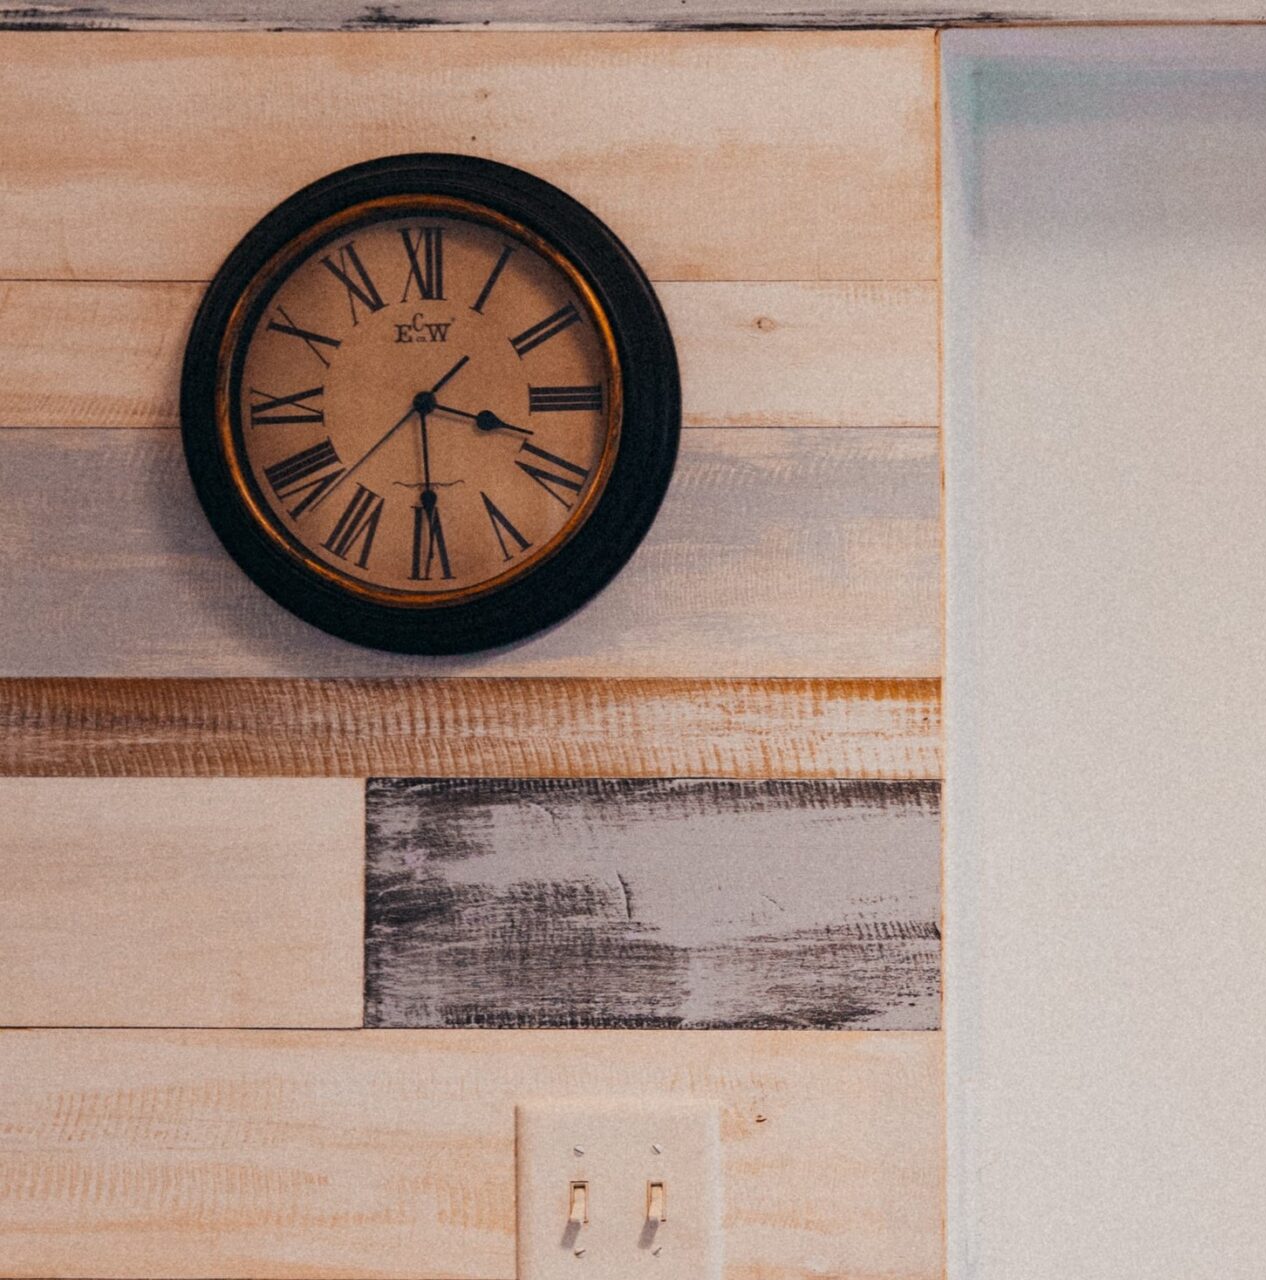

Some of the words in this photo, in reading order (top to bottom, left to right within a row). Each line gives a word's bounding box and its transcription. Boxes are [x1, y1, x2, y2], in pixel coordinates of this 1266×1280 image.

[319, 240, 390, 326] XI
[398, 227, 447, 303] XII
[470, 244, 518, 316] I
[266, 305, 341, 368] X
[508, 302, 583, 360] II
[250, 386, 325, 429] IX
[528, 383, 603, 416] III
[514, 439, 594, 512] IV
[320, 482, 386, 570] VII
[480, 491, 535, 562] V
